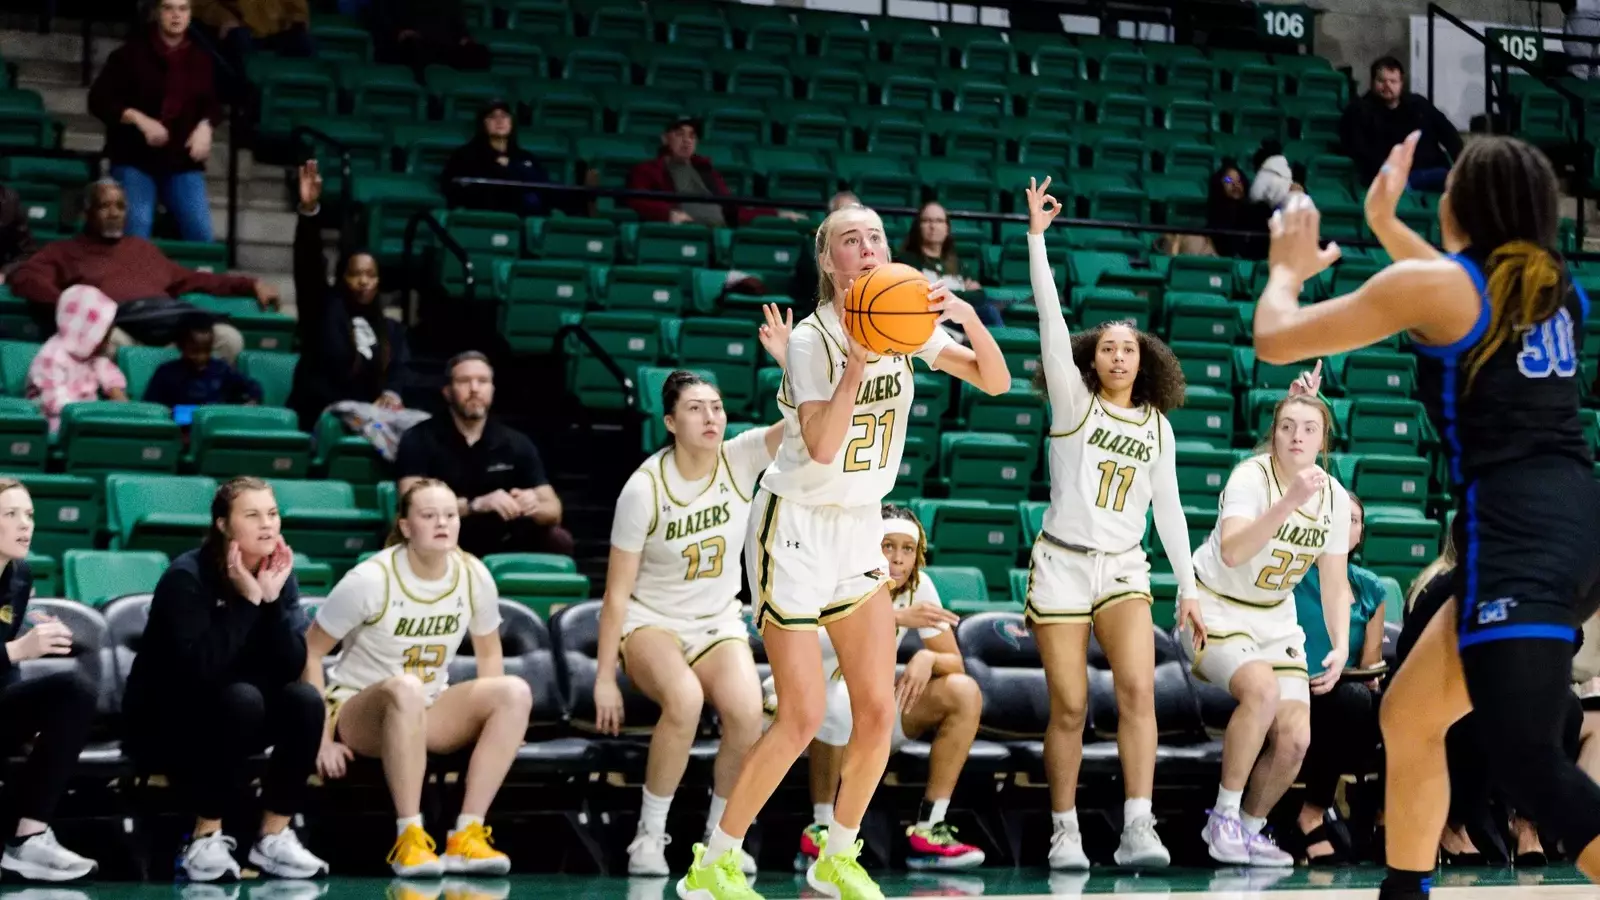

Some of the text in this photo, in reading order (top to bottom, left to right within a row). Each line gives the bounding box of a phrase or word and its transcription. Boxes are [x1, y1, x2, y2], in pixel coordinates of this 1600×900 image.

[1263, 10, 1305, 38] 106
[1498, 34, 1538, 62] 105
[1515, 304, 1578, 378] 30
[854, 371, 902, 405] LAZERS
[843, 409, 896, 473] 21
[1087, 427, 1153, 463] BLAZERS
[1095, 459, 1136, 512] 11
[665, 502, 731, 541] BLAZERS
[682, 535, 726, 580] 13
[1254, 548, 1315, 591] 22
[393, 612, 461, 637] BLAZERS
[402, 643, 447, 684] 12
